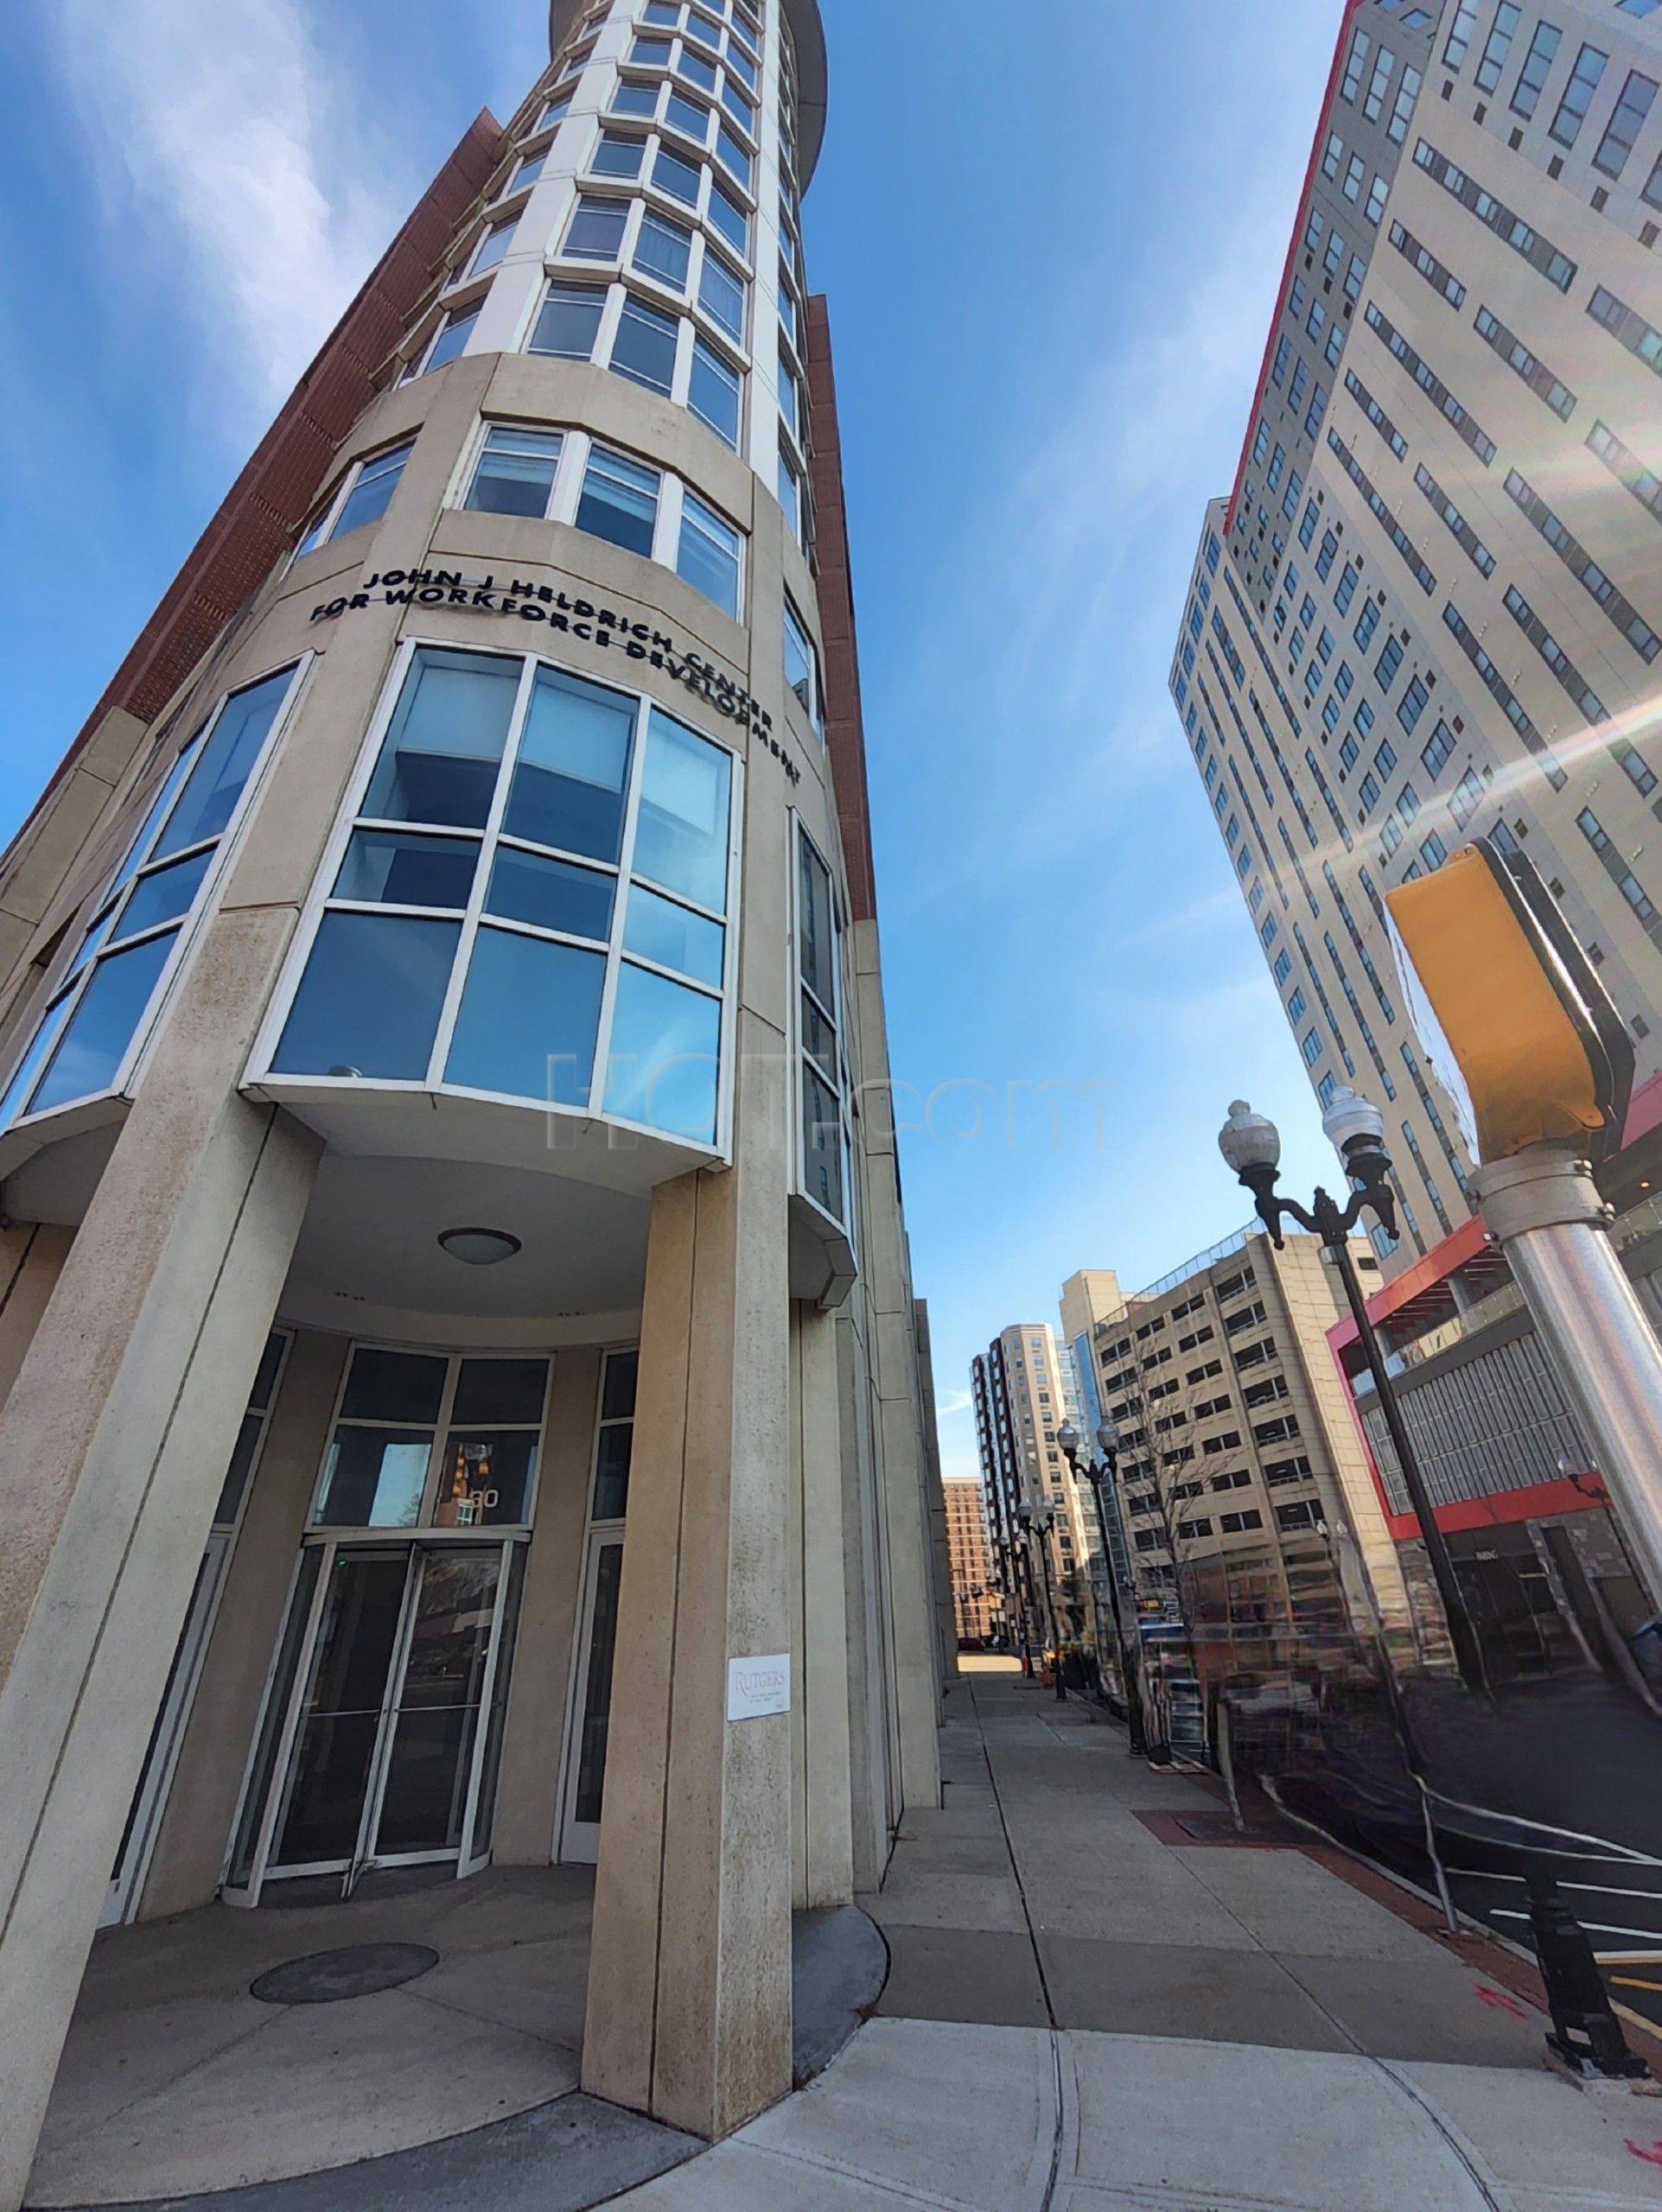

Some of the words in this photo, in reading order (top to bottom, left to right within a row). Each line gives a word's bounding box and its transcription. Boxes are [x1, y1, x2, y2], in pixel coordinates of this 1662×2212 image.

[309, 593, 370, 621] FOR
[385, 588, 610, 647] WORKFORCE
[626, 639, 801, 788] DEVELOPMENT
[363, 569, 462, 589] JOHN
[478, 575, 494, 590] J
[511, 580, 672, 652] HELDRICH
[685, 652, 773, 733] CENTER
